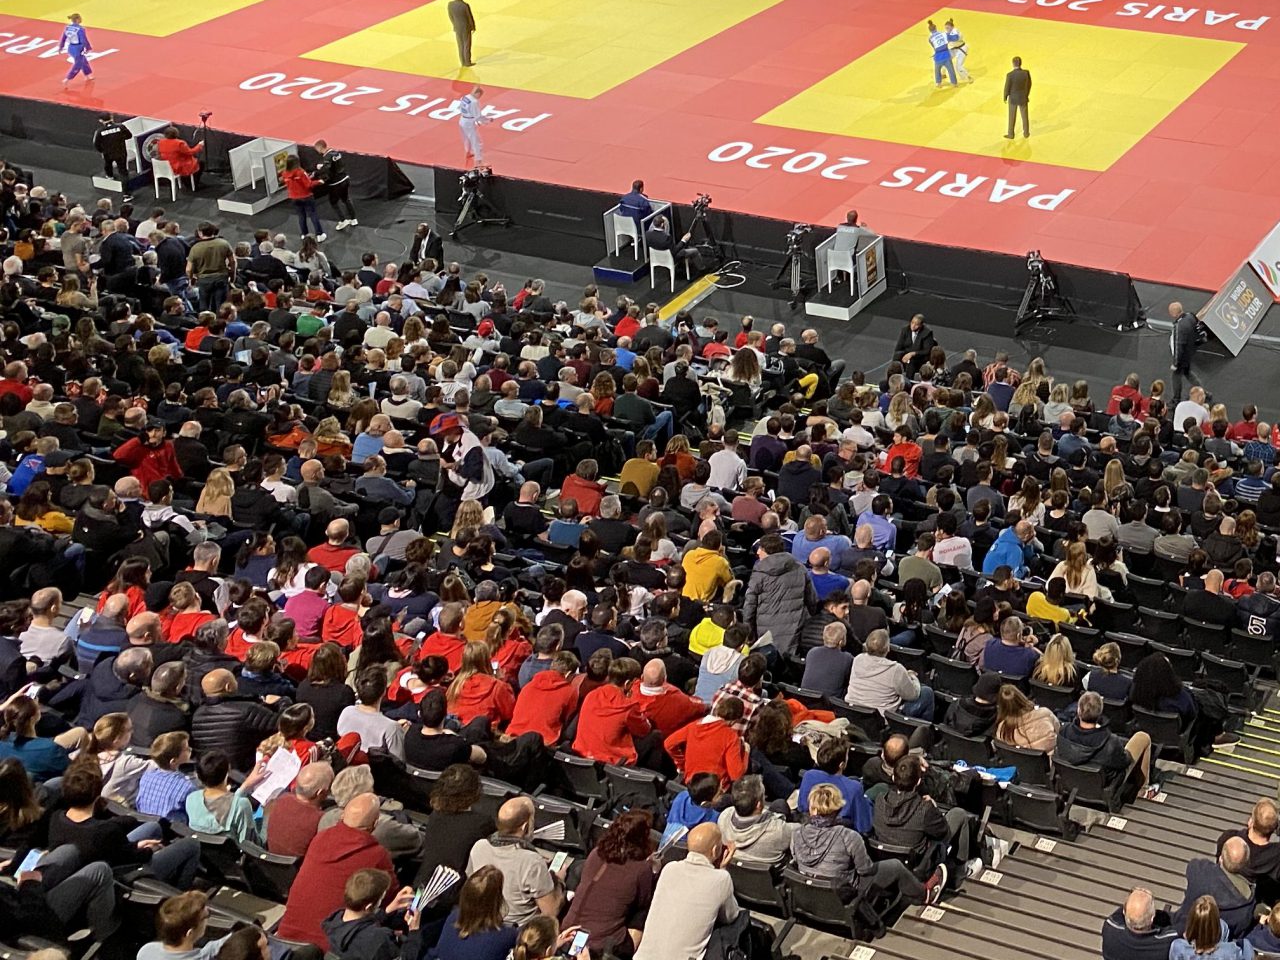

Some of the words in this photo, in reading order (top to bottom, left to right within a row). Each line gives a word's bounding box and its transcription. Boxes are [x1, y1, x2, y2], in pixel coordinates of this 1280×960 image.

[1114, 1, 1272, 31] PARIS
[239, 72, 385, 106] 2020
[378, 93, 552, 132] PARIS
[707, 140, 868, 180] 2020
[880, 166, 1076, 211] PARIS
[1230, 280, 1247, 301] WORLD
[1237, 288, 1254, 308] JUDO
[1245, 297, 1263, 319] TOUR
